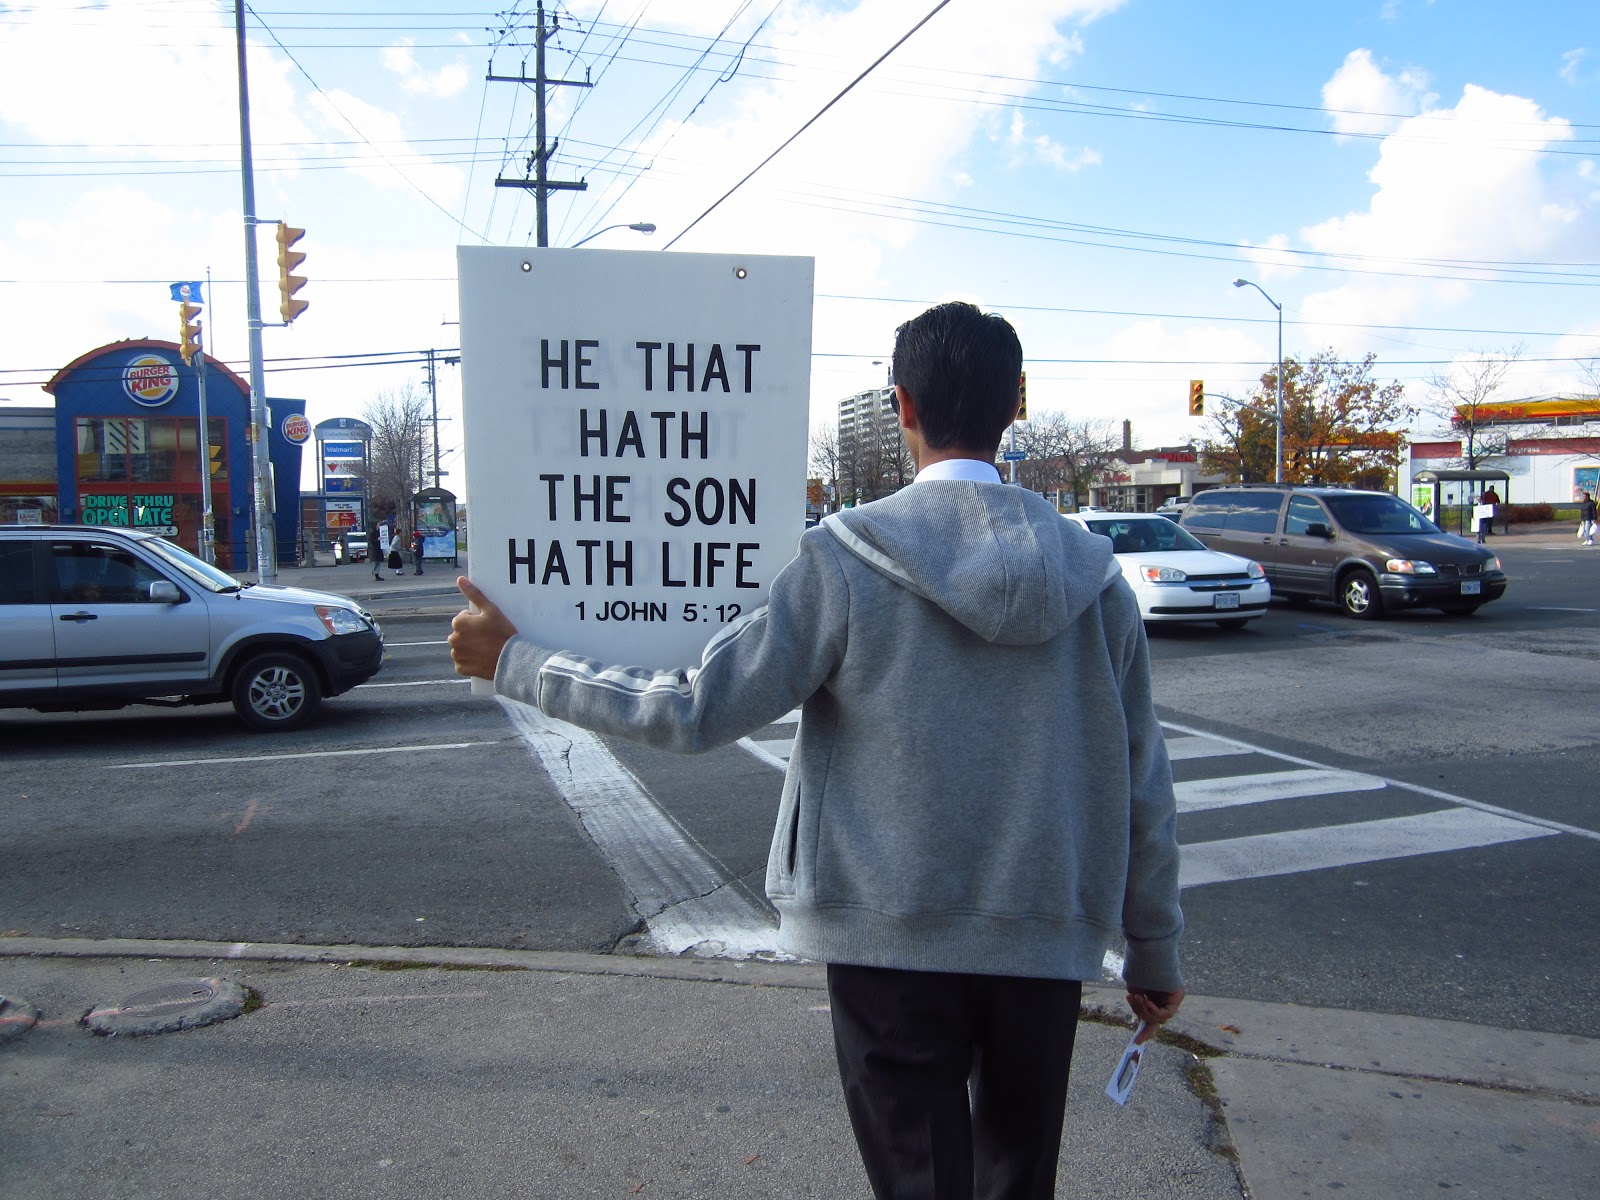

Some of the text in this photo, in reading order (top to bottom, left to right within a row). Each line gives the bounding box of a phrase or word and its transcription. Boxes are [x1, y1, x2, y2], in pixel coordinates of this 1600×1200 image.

[130, 366, 170, 378] BURGER
[540, 339, 761, 393] HE THAT
[131, 374, 171, 394] KING
[286, 420, 308, 431] BURGER
[287, 426, 309, 437] KING
[579, 409, 708, 459] HATH
[86, 495, 128, 507] DRIVE
[539, 474, 756, 527] THE SON
[82, 508, 172, 527] OPEN LATE
[508, 538, 760, 589] HATH LIFE
[575, 600, 742, 623] 1 JOHN 5:12
